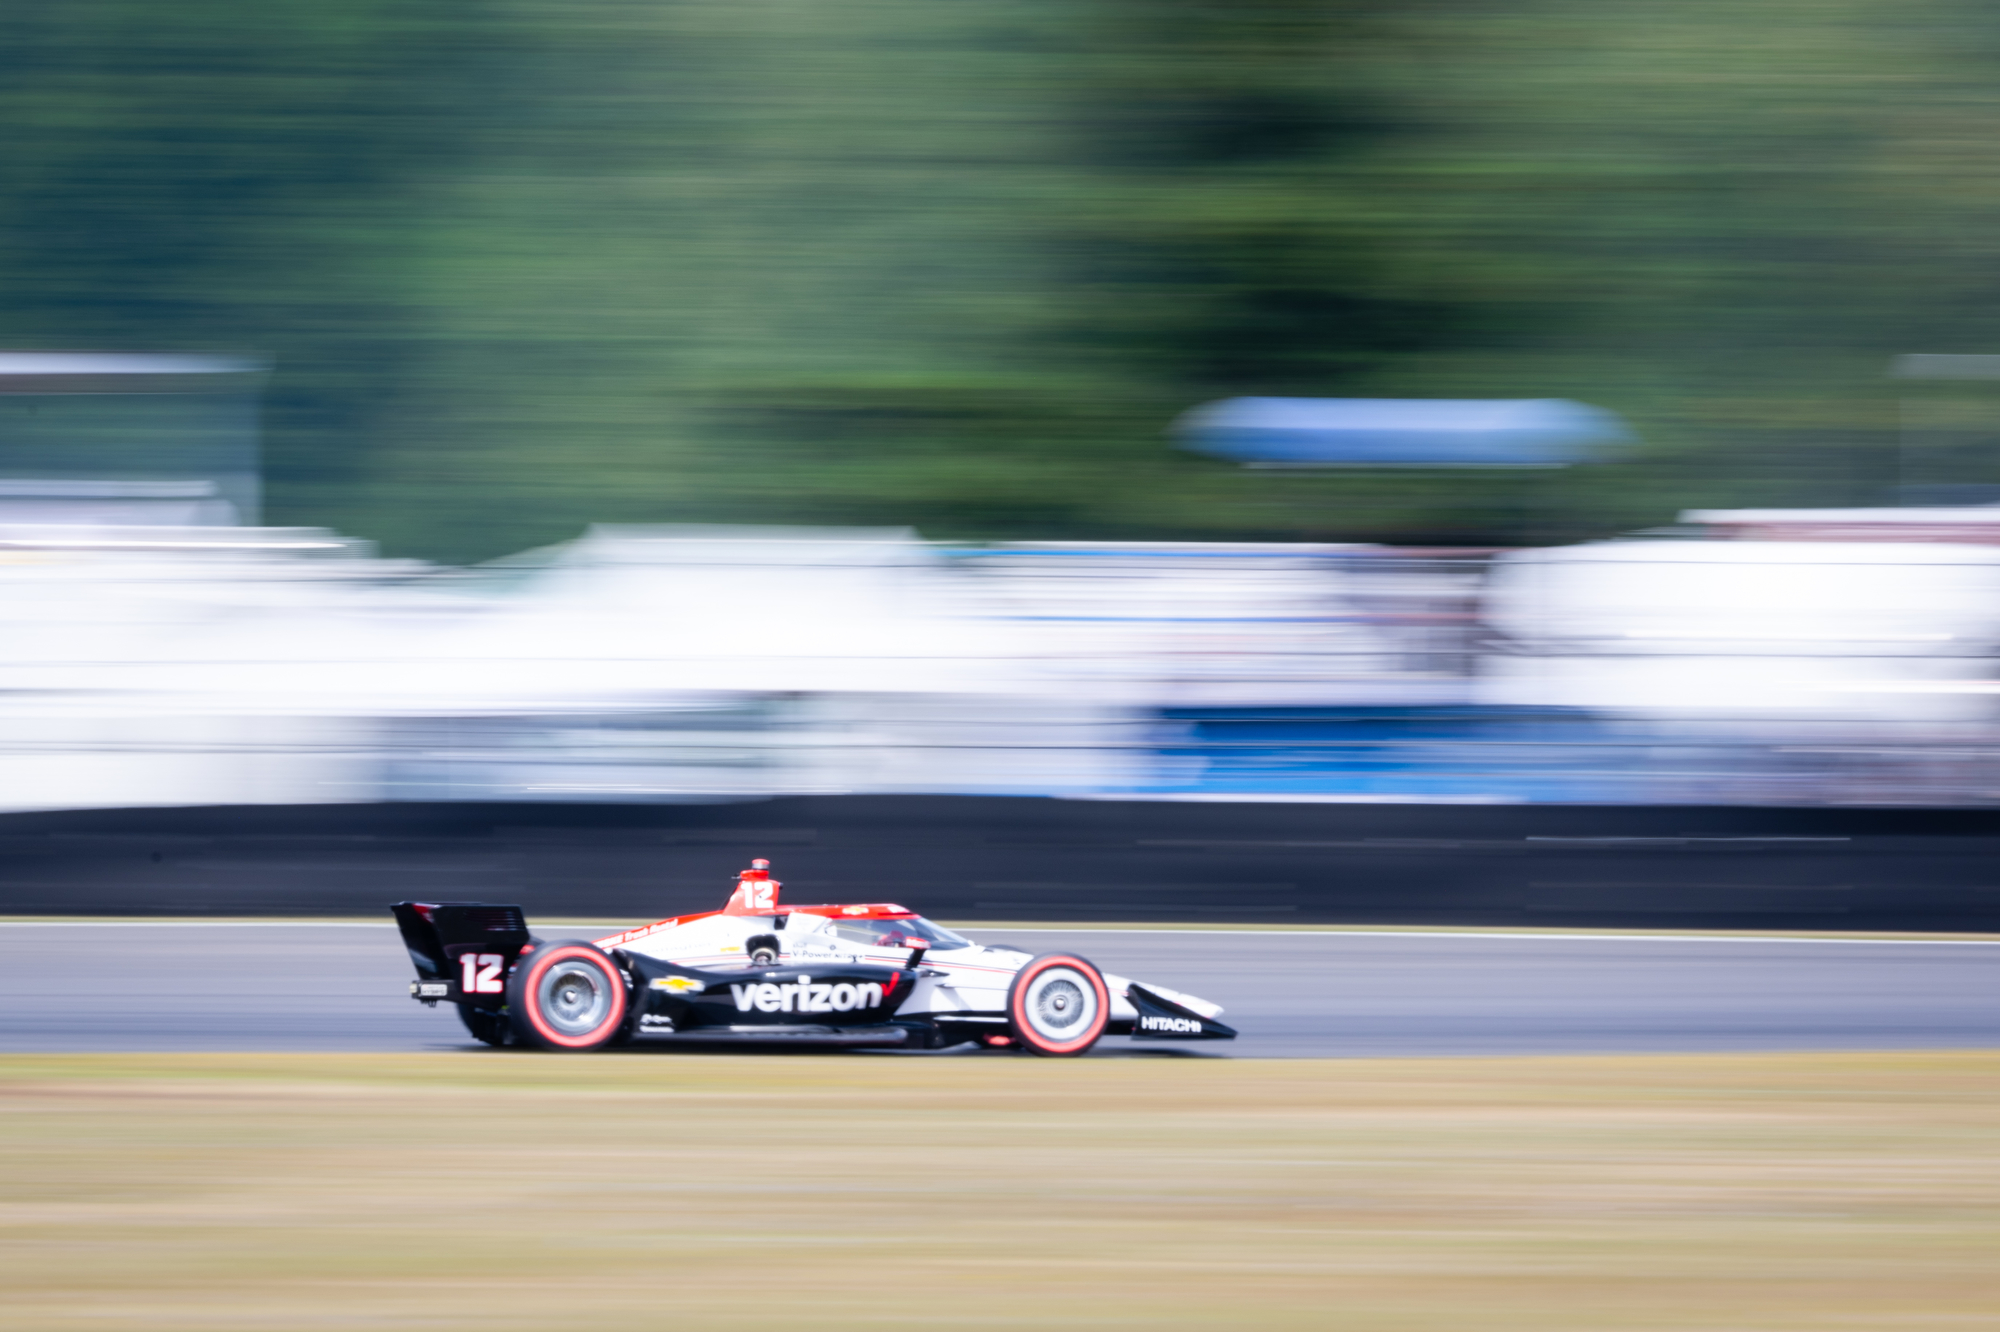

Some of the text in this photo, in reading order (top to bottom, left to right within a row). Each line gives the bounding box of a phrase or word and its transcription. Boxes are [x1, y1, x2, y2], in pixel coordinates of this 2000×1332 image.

[740, 881, 774, 909] 12
[459, 953, 504, 993] 12
[730, 975, 884, 1013] verizon
[1141, 1016, 1202, 1033] HITACHI
